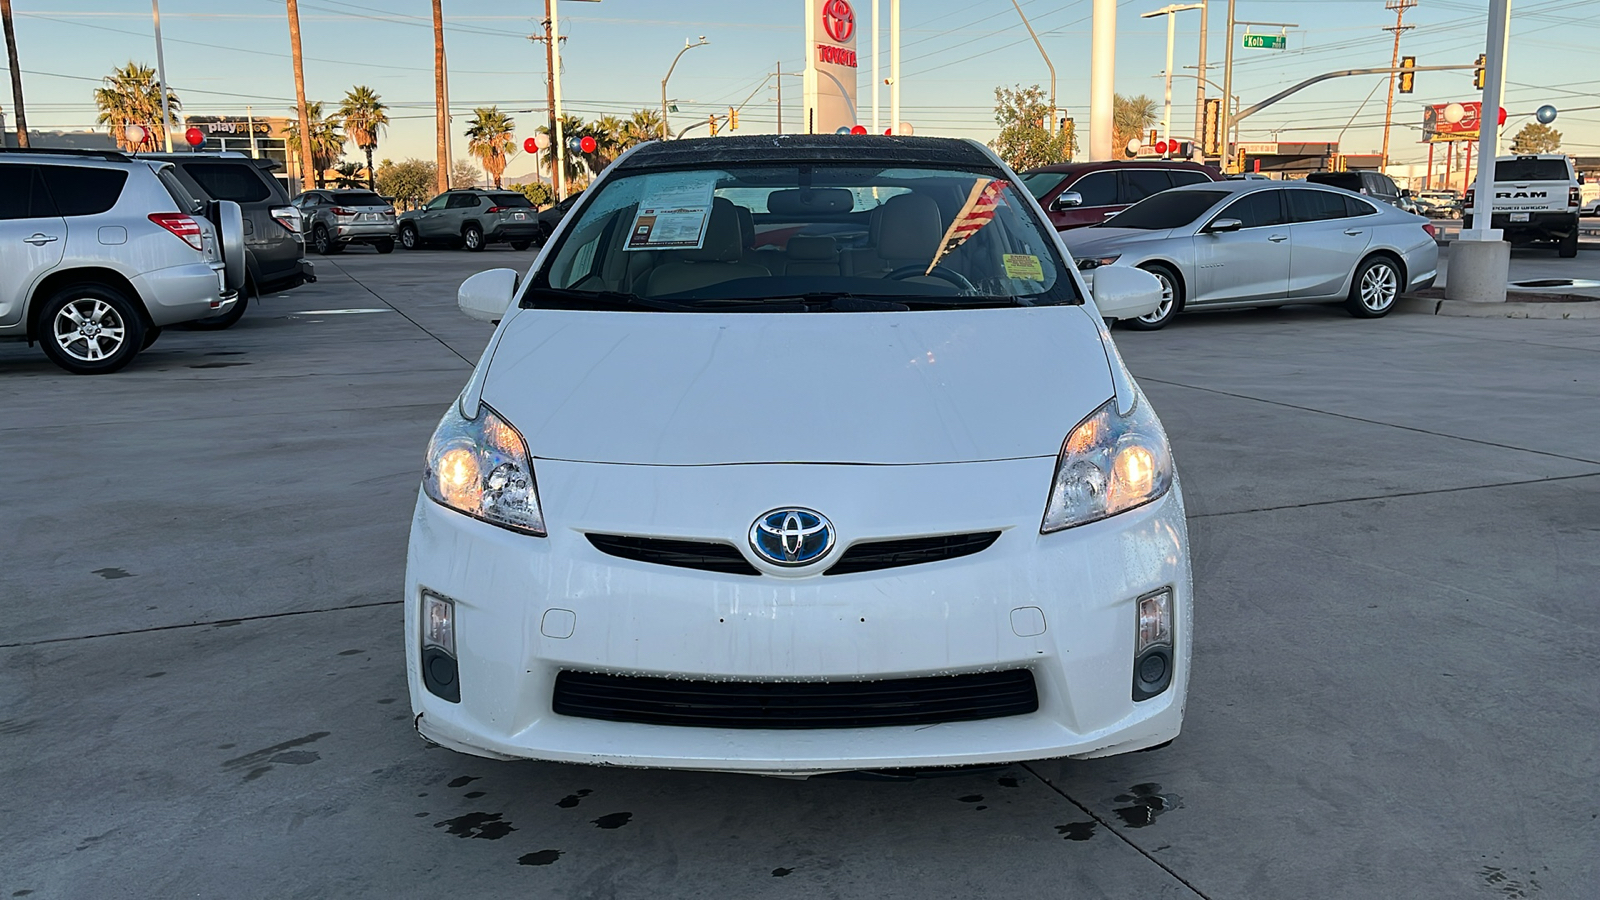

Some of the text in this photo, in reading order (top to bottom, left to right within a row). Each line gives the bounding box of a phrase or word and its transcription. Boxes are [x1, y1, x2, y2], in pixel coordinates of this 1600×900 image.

[1248, 36, 1263, 47] Kolb
[817, 44, 858, 68] TOYOTA
[1495, 191, 1548, 199] RAM
